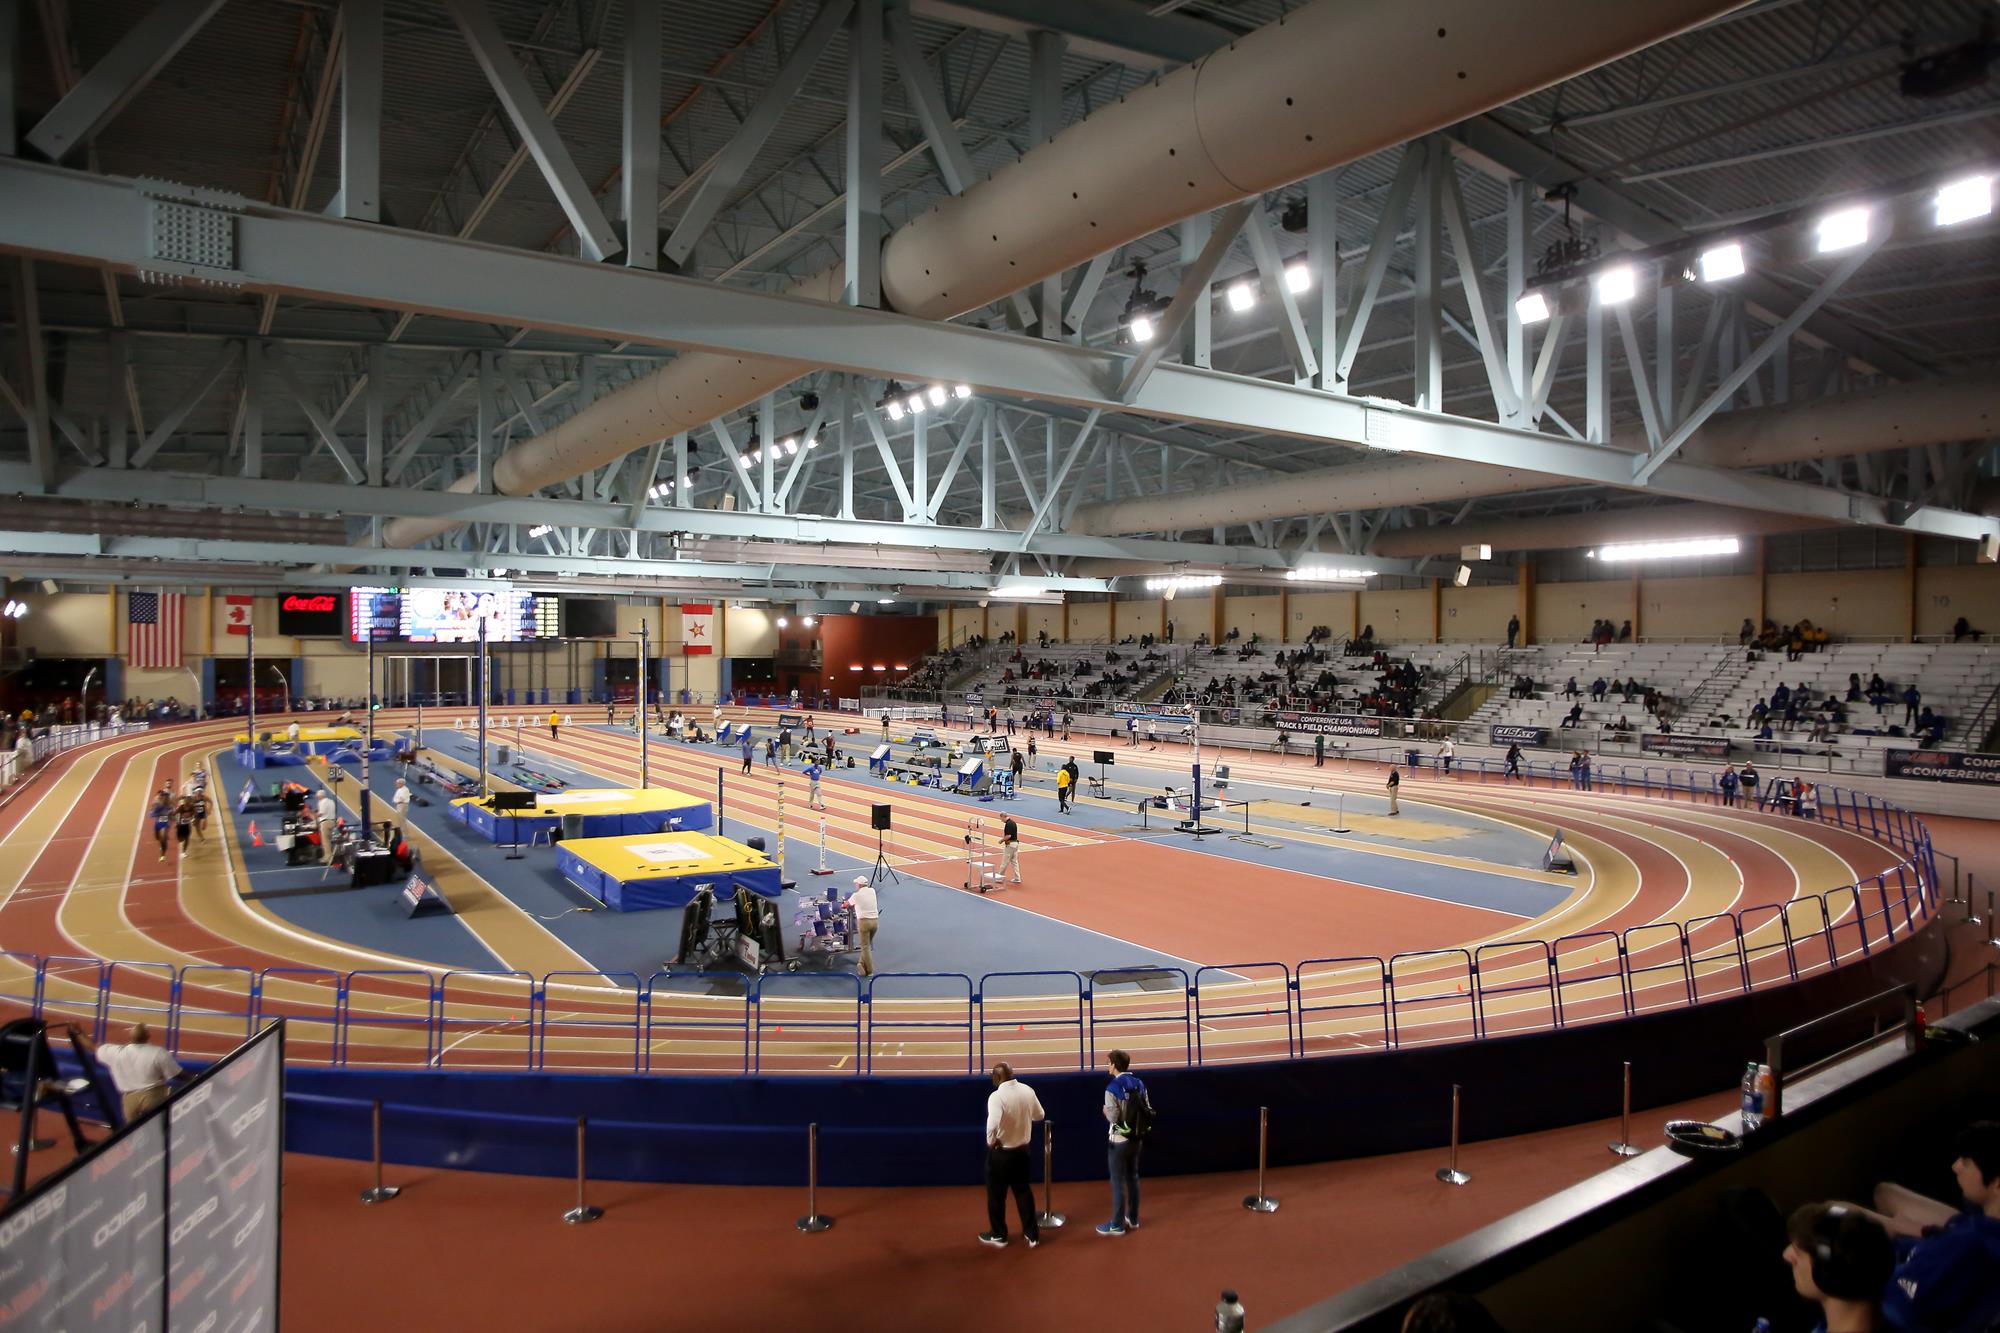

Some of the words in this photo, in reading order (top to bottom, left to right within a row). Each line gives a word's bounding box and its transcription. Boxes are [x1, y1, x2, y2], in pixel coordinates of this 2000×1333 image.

[1300, 716, 1338, 725] CONFERENCE
[1276, 721, 1297, 729] TRACK
[1303, 723, 1322, 731] FIELD
[1323, 725, 1380, 735] CHAMPIONSHIPS
